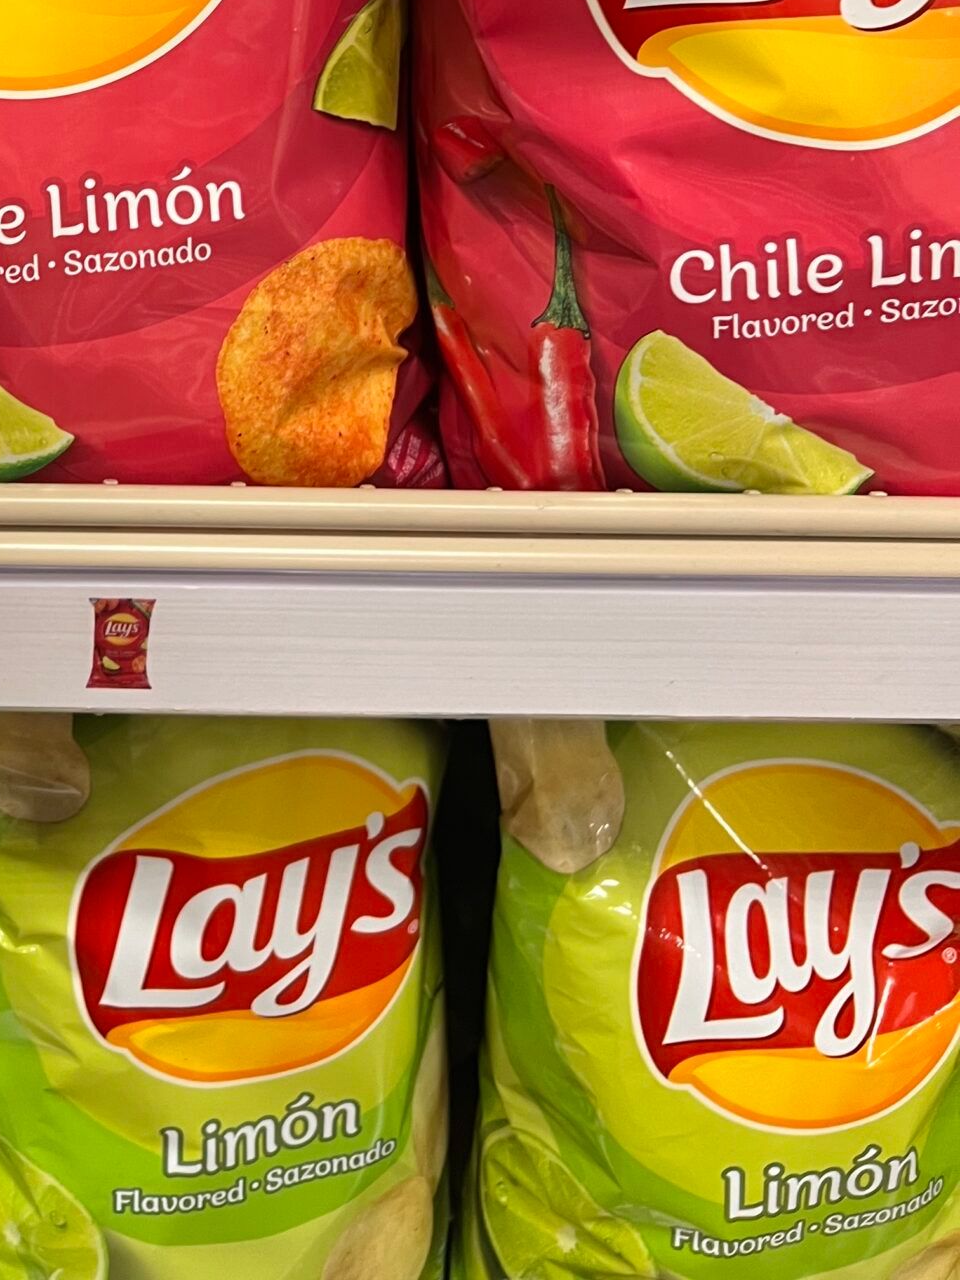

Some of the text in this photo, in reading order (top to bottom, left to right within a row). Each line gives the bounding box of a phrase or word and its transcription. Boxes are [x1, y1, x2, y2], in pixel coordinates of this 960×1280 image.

[45, 164, 246, 240] Limón
[62, 236, 212, 277] Sazonado
[669, 237, 844, 305] Chile
[711, 296, 960, 340] Flavored Sazo
[98, 811, 422, 1018] Lay's
[662, 841, 960, 1057] Lay's
[162, 1094, 359, 1177] Limón
[113, 1137, 396, 1215] Flavored Sazonado
[723, 1144, 921, 1222] Limón
[672, 1176, 945, 1260] Flavored Sazonado
